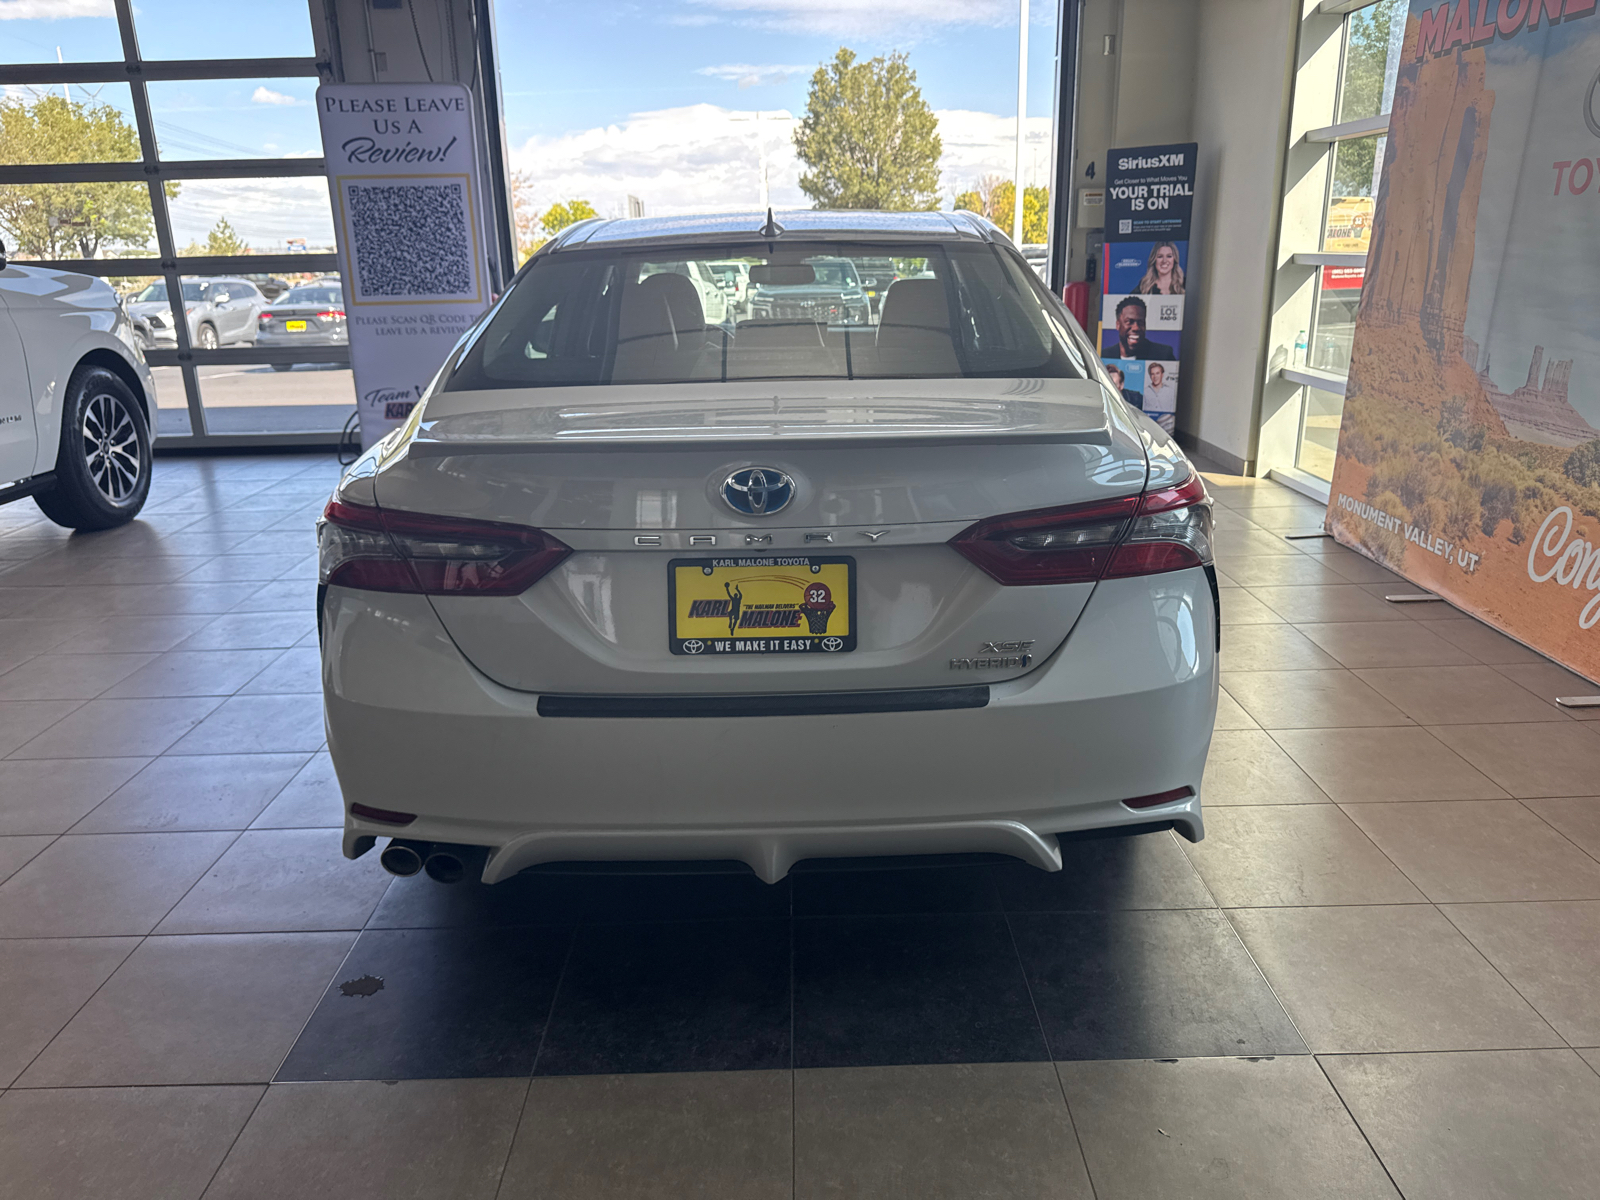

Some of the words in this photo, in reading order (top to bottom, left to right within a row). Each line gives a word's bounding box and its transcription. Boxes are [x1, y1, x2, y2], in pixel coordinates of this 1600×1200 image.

[325, 96, 397, 113] PLEASE
[404, 96, 465, 112] LEAVE
[373, 119, 401, 135] US
[407, 119, 423, 134] A
[341, 136, 457, 164] Review!
[1118, 153, 1184, 171] SiriusXM
[1085, 161, 1096, 180] 4
[1552, 158, 1600, 196] TO
[1109, 186, 1148, 200] YOUR
[1150, 184, 1193, 197] TRIAL
[1131, 199, 1145, 211] IS
[1147, 197, 1169, 210] ON
[1326, 228, 1352, 239] ALONE
[355, 316, 389, 326] PLEASE
[391, 315, 416, 325] SCAN
[420, 313, 436, 326] QR
[439, 314, 466, 324] CODE
[1160, 307, 1177, 316] LOL
[375, 326, 401, 336] LEAVE
[405, 326, 418, 335] US
[420, 327, 428, 335] A
[364, 387, 410, 408] Team
[634, 530, 890, 546] CAMRY
[1337, 493, 1402, 534] MONUMENT
[1404, 525, 1454, 565] VALLEY,
[1457, 550, 1480, 572] UT
[712, 559, 736, 567] KARL
[738, 558, 775, 567] MALONE
[777, 558, 810, 566] TOYOTA
[809, 589, 826, 603] 32
[688, 599, 731, 618] KARL
[738, 610, 802, 629] MALONE
[715, 641, 731, 652] WE
[736, 640, 766, 651] MAKE
[770, 640, 780, 650] IT
[784, 639, 811, 650] EASY
[979, 639, 1036, 653] XSE
[949, 657, 1019, 670] HYBRID
